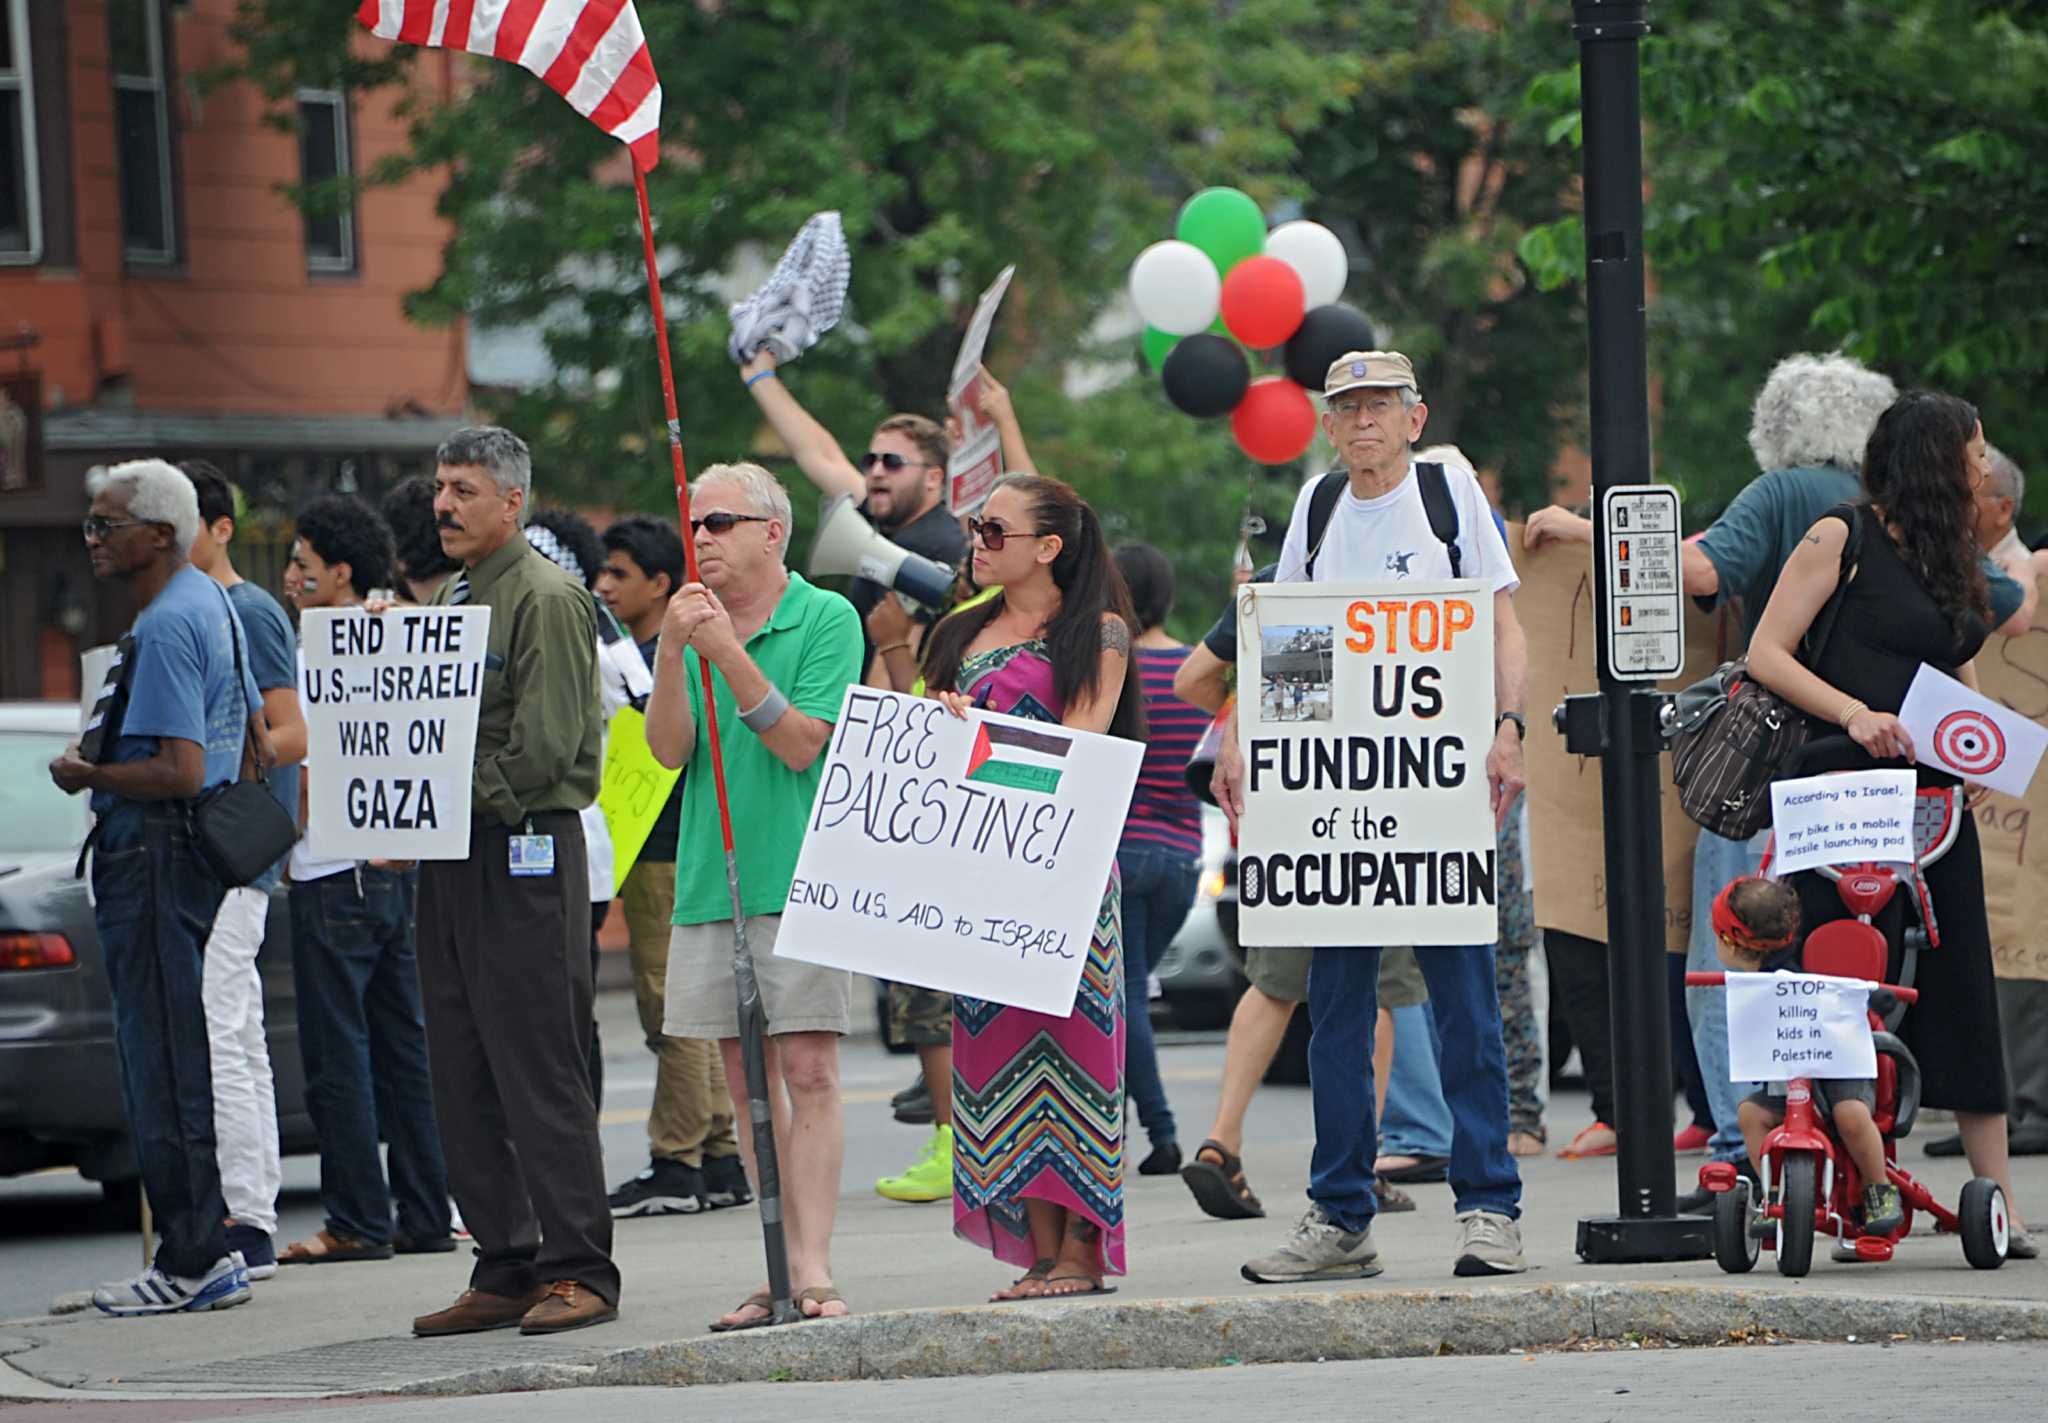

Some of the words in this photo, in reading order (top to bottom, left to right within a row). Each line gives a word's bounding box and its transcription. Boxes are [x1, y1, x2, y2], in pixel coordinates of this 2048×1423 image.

[331, 617, 384, 656] END
[403, 615, 463, 653] THE
[1345, 600, 1475, 654] STOP
[1373, 664, 1443, 718] US
[339, 720, 390, 756] WAR
[408, 718, 446, 755] ON
[836, 692, 944, 770] FREE
[1249, 735, 1467, 792] FUNDING
[347, 777, 438, 829] GAZA
[1783, 791, 1840, 807] According
[1845, 788, 1857, 799] to
[1862, 784, 1903, 797] Israel,
[813, 762, 1075, 870] PALESTINE!
[1311, 807, 1342, 840] of
[1351, 807, 1398, 840] the
[1788, 829, 1804, 842] my
[1807, 823, 1829, 837] bike
[1835, 820, 1845, 831] is
[1850, 822, 1857, 830] a
[1862, 818, 1900, 830] mobile
[1784, 842, 1819, 858] missile
[1823, 835, 1878, 849] launching
[1882, 835, 1905, 848] pad
[1239, 850, 1495, 907] OCCUPATION
[789, 878, 838, 911] END
[898, 903, 943, 930] AID
[954, 915, 973, 936] to
[980, 918, 1074, 959] ISRAEL
[1776, 980, 1826, 996] STOP
[1777, 1027, 1803, 1040] kids
[1809, 1026, 1822, 1039] in
[1779, 1006, 1818, 1021] killing
[1772, 1048, 1833, 1062] Palestine
